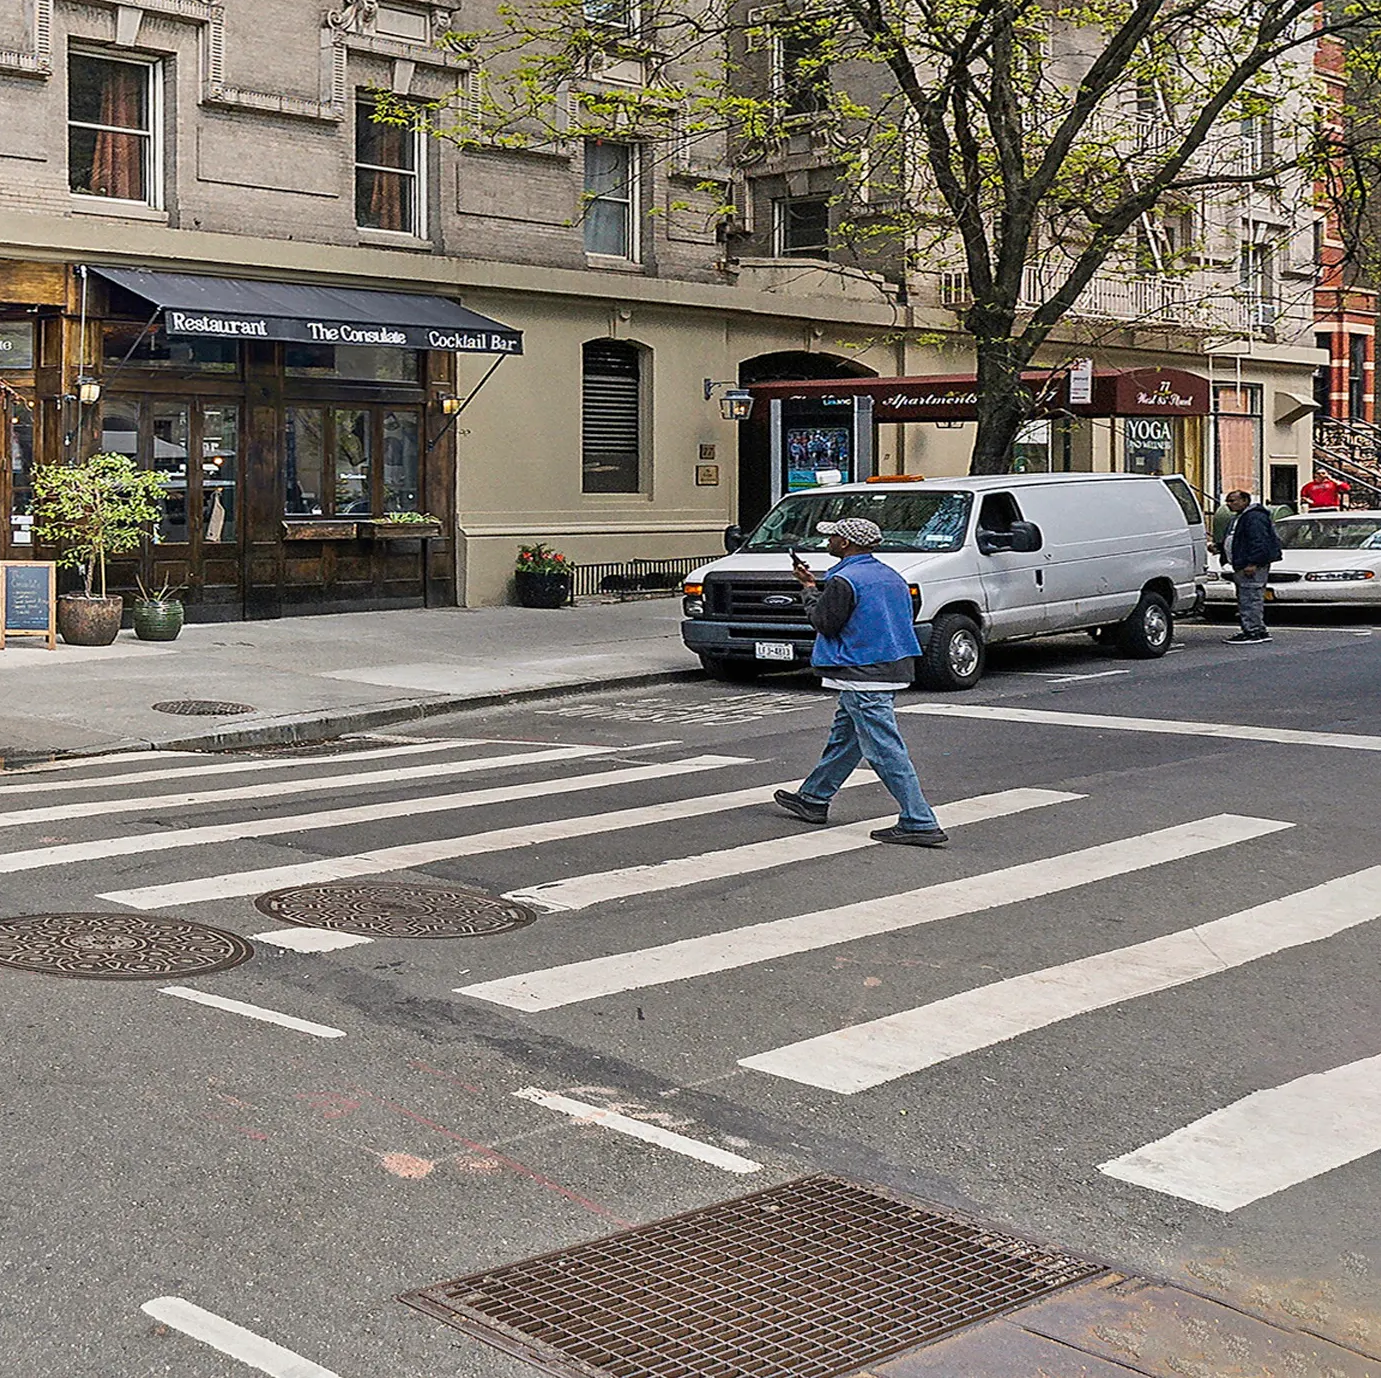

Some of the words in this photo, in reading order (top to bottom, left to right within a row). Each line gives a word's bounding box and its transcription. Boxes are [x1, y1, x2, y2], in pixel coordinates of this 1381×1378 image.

[172, 312, 268, 336] Restaurant
[307, 323, 339, 342] The
[340, 326, 406, 344] Consulate
[429, 330, 487, 349] Cocktail
[491, 337, 517, 351] Bar
[883, 392, 978, 409] Apartments
[1128, 420, 1171, 441] YOGA
